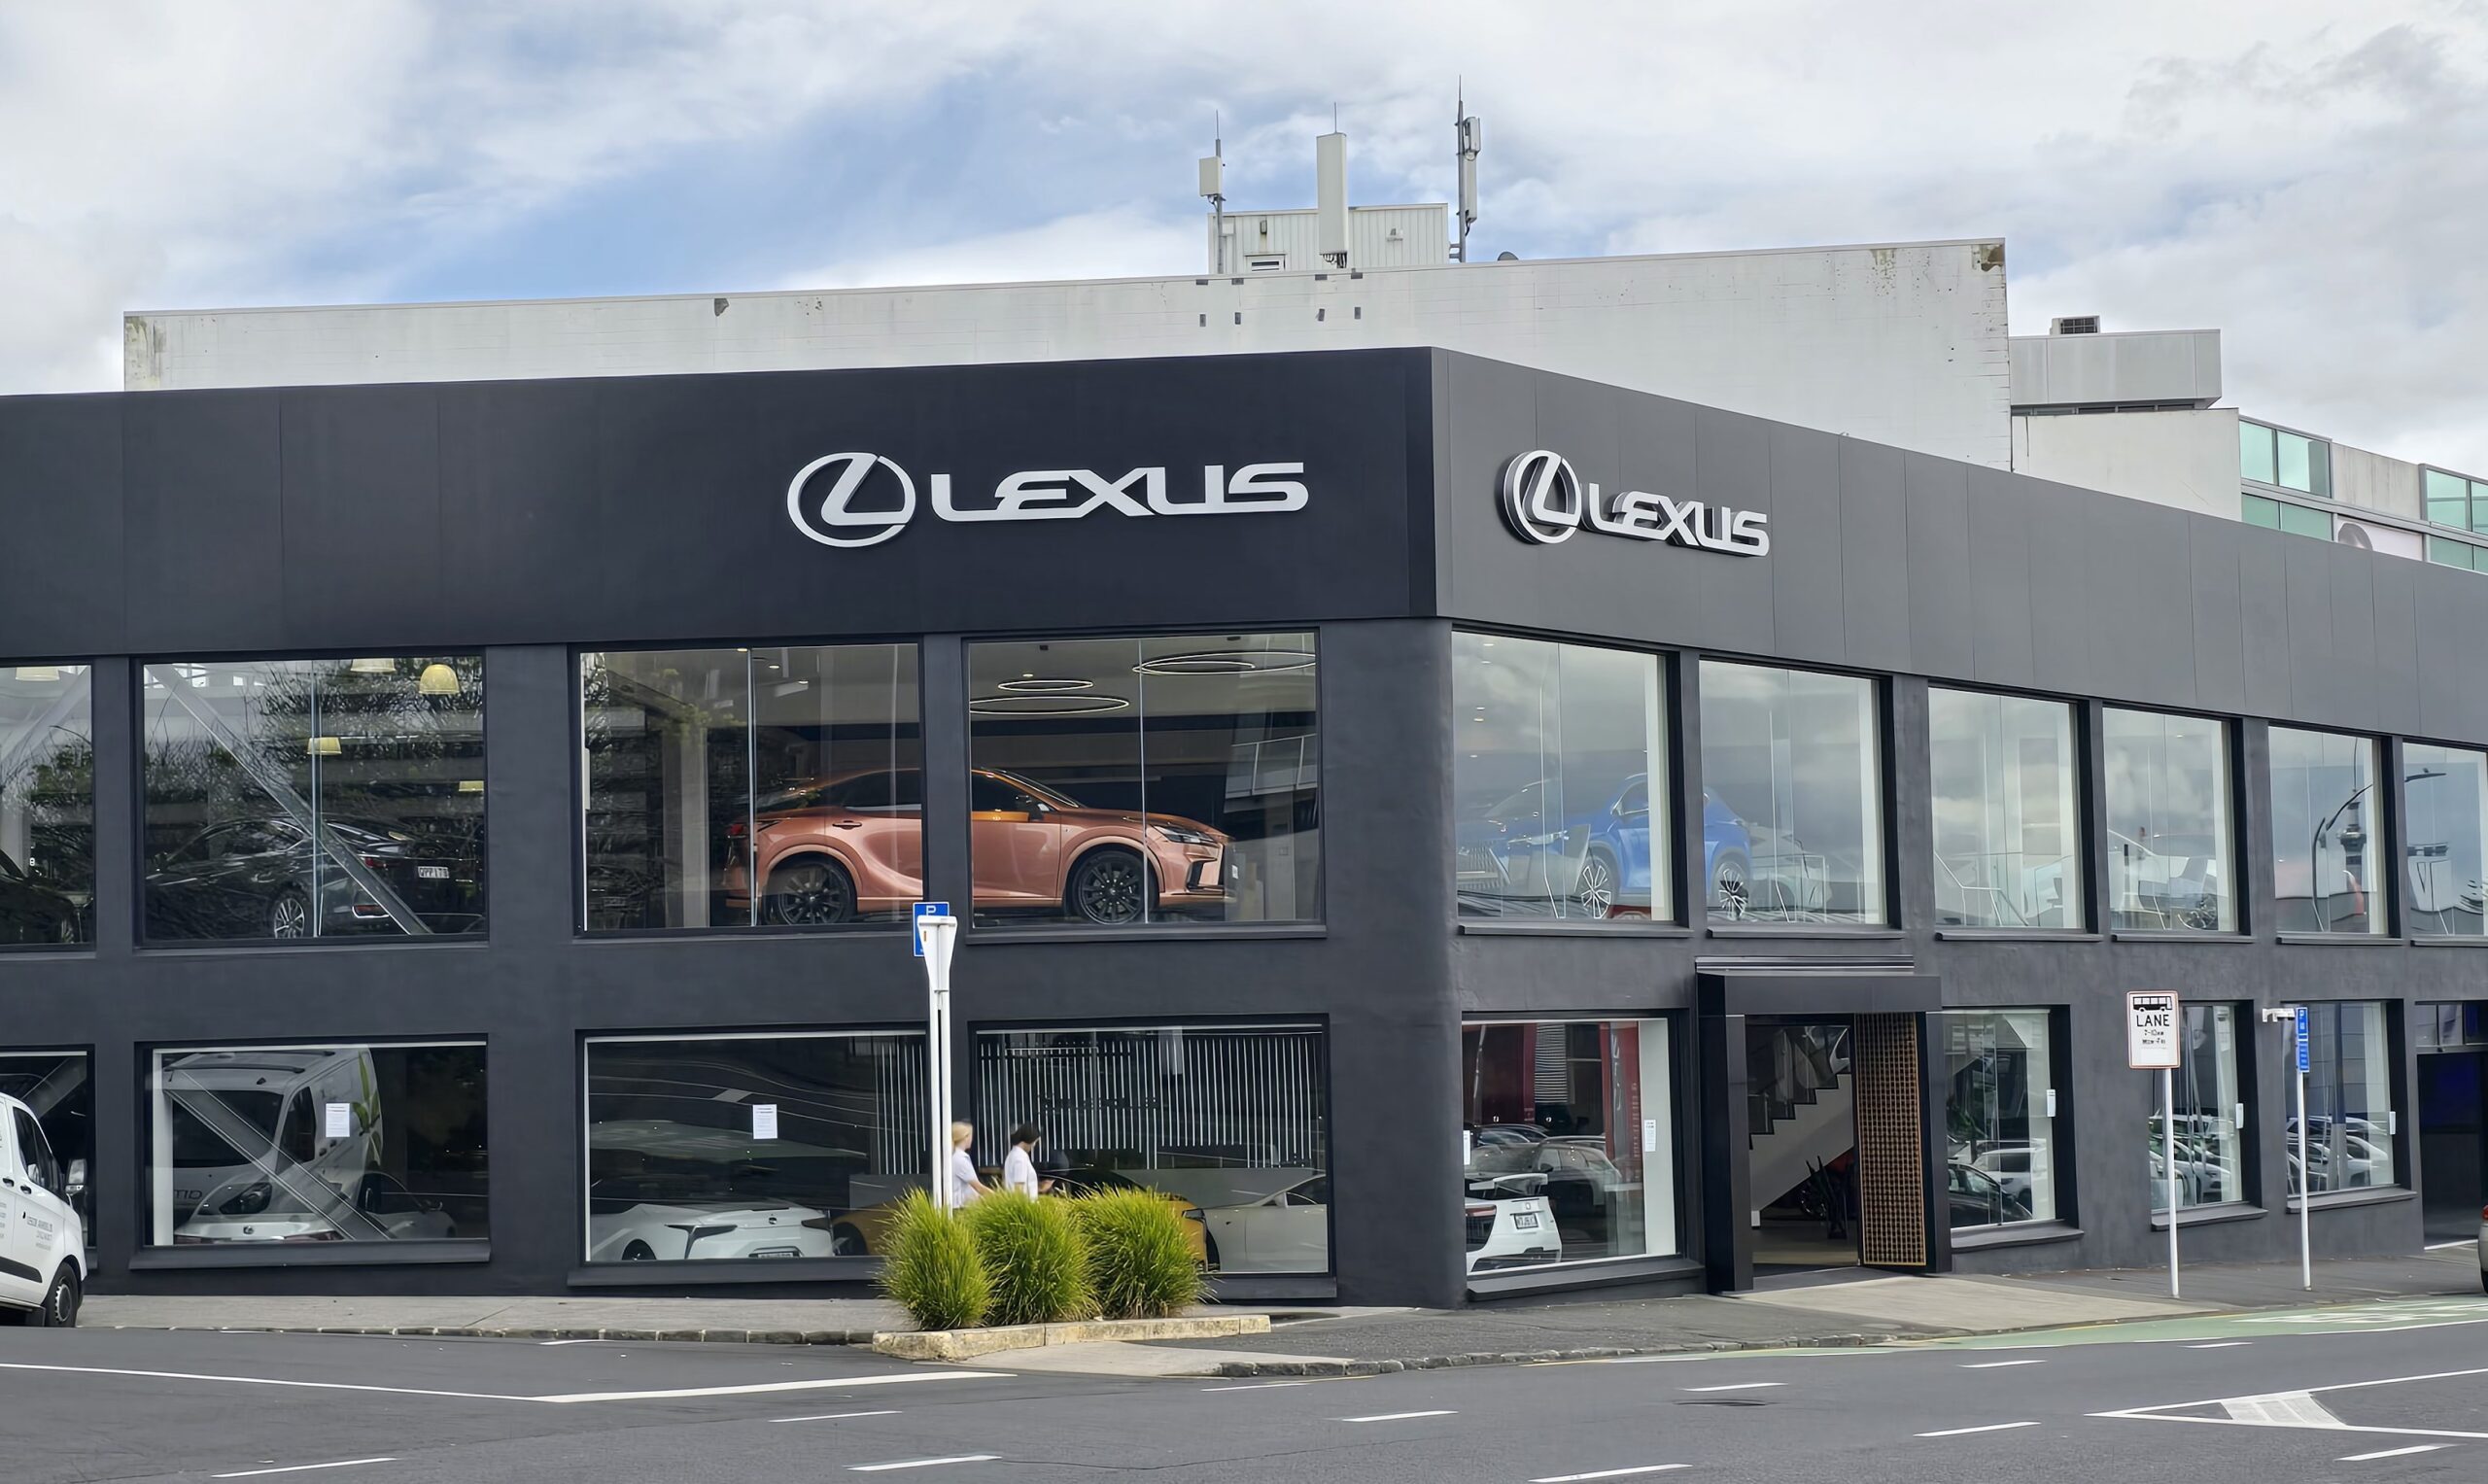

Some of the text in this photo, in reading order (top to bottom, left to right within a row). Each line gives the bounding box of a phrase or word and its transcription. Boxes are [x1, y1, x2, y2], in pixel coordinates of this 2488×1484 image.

[930, 462, 1310, 523] LEXUS
[1586, 482, 1770, 557] LEXUS
[926, 905, 937, 916] P
[2136, 1014, 2170, 1027] LANE
